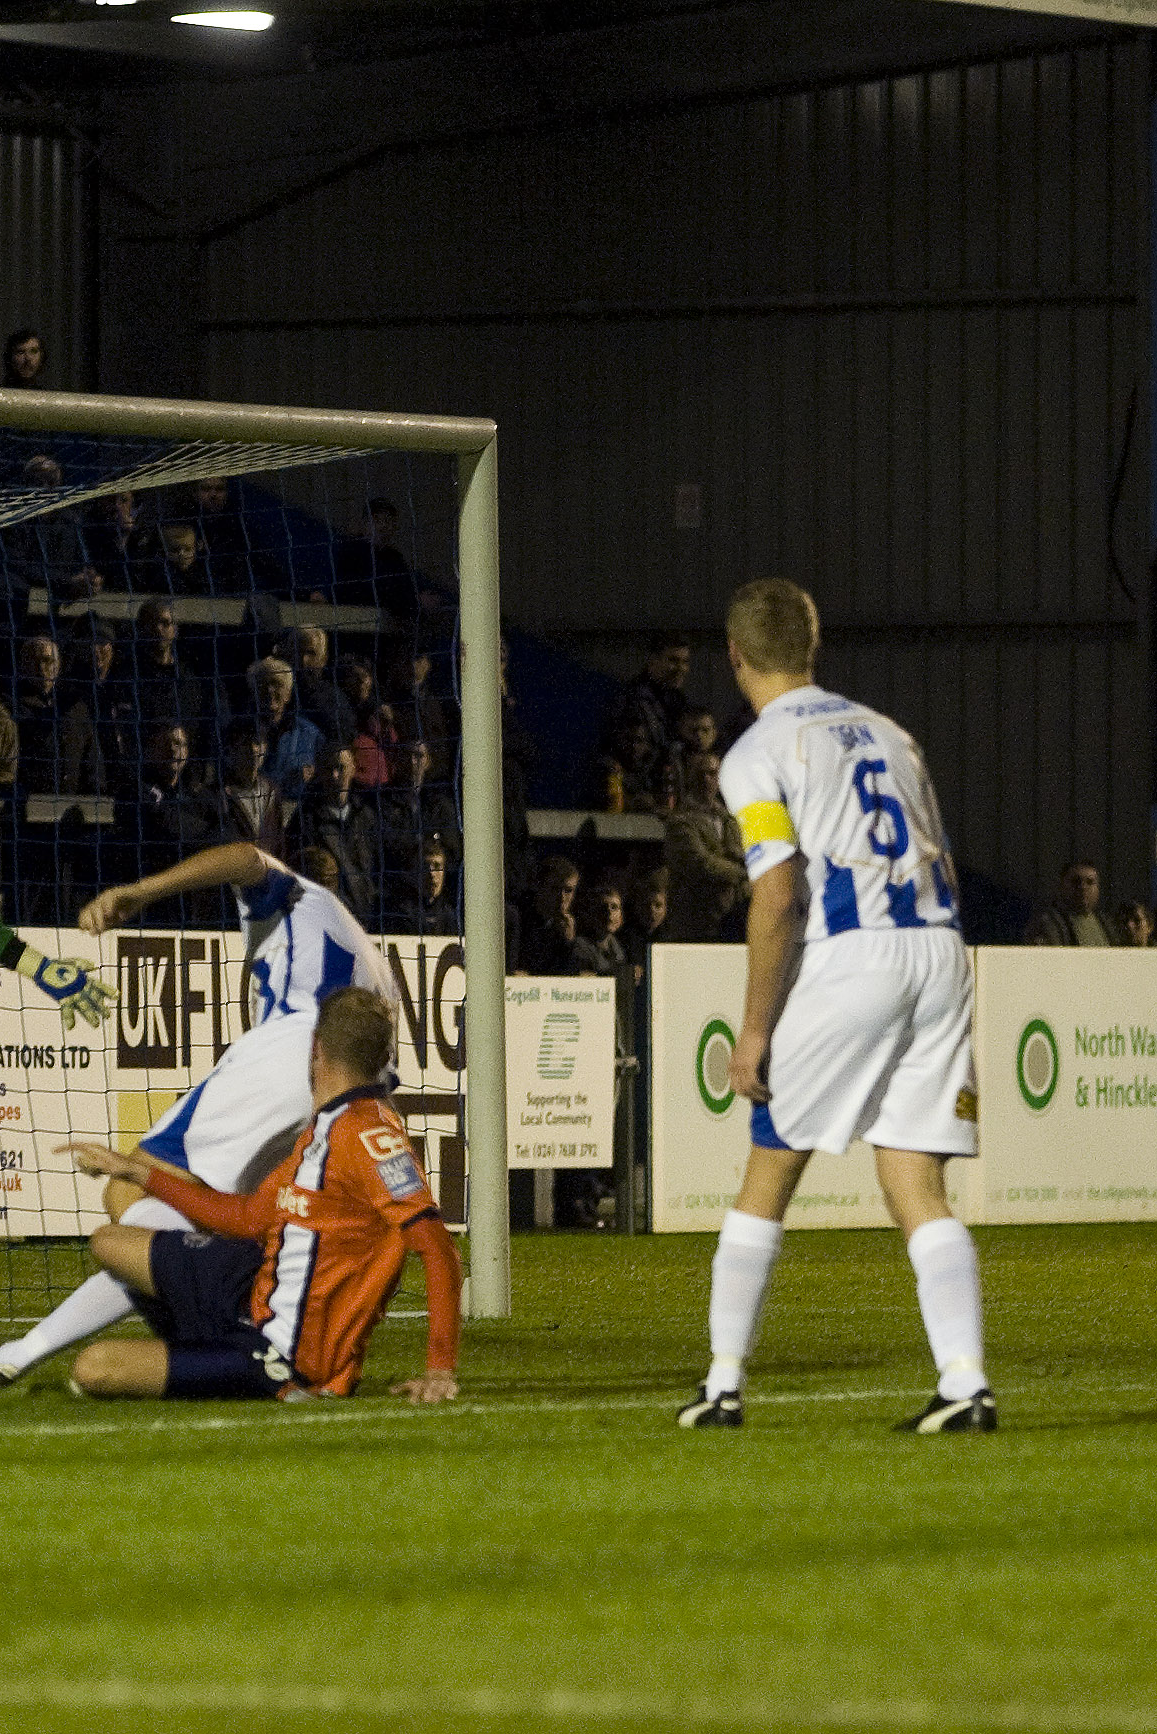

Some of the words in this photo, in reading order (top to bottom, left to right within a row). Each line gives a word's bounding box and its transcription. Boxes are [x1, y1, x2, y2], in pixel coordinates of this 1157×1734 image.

[119, 955, 170, 1048] UK
[1075, 1024, 1126, 1057] North
[1129, 1025, 1157, 1057] Wa
[61, 1045, 91, 1069] LTD
[526, 1091, 571, 1109] Supporting
[574, 1090, 588, 1105] the
[1075, 1075, 1089, 1108] &
[520, 1111, 543, 1126] Local
[545, 1111, 592, 1129] Community
